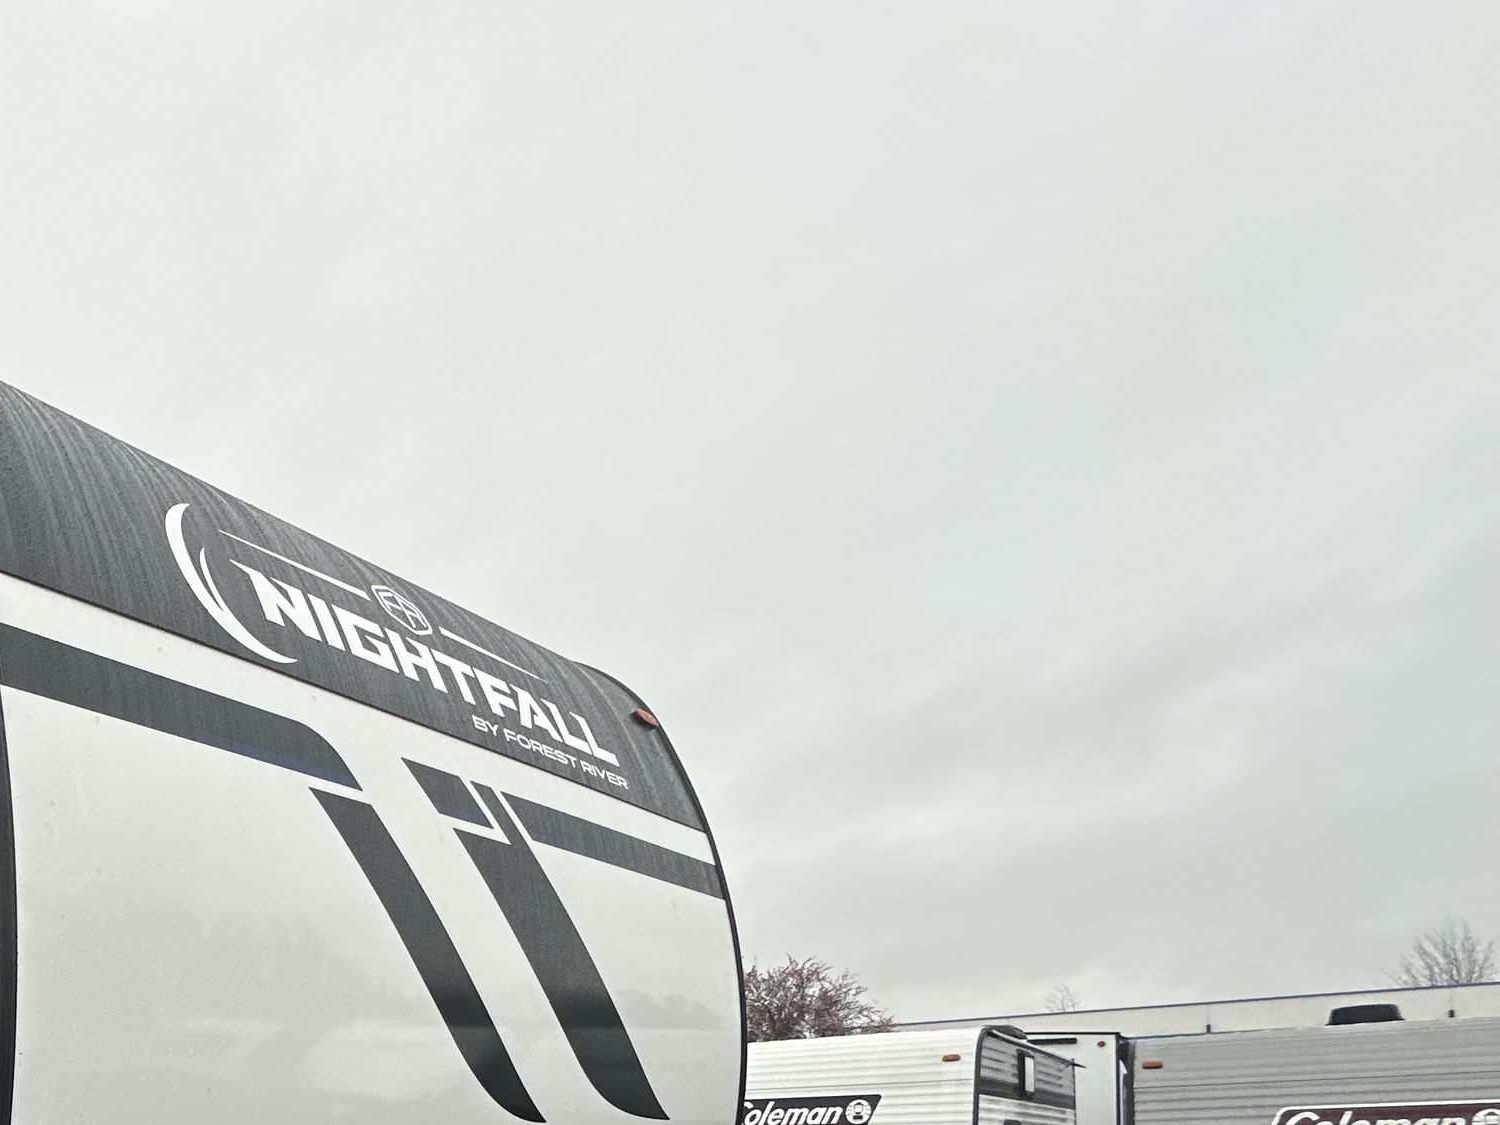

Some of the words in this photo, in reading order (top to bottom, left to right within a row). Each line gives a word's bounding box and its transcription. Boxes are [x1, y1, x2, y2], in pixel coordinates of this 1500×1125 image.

[229, 559, 620, 767] NIGHTFALL
[471, 714, 499, 737] BY
[503, 728, 577, 768] FOREST
[580, 760, 629, 790] RIVER
